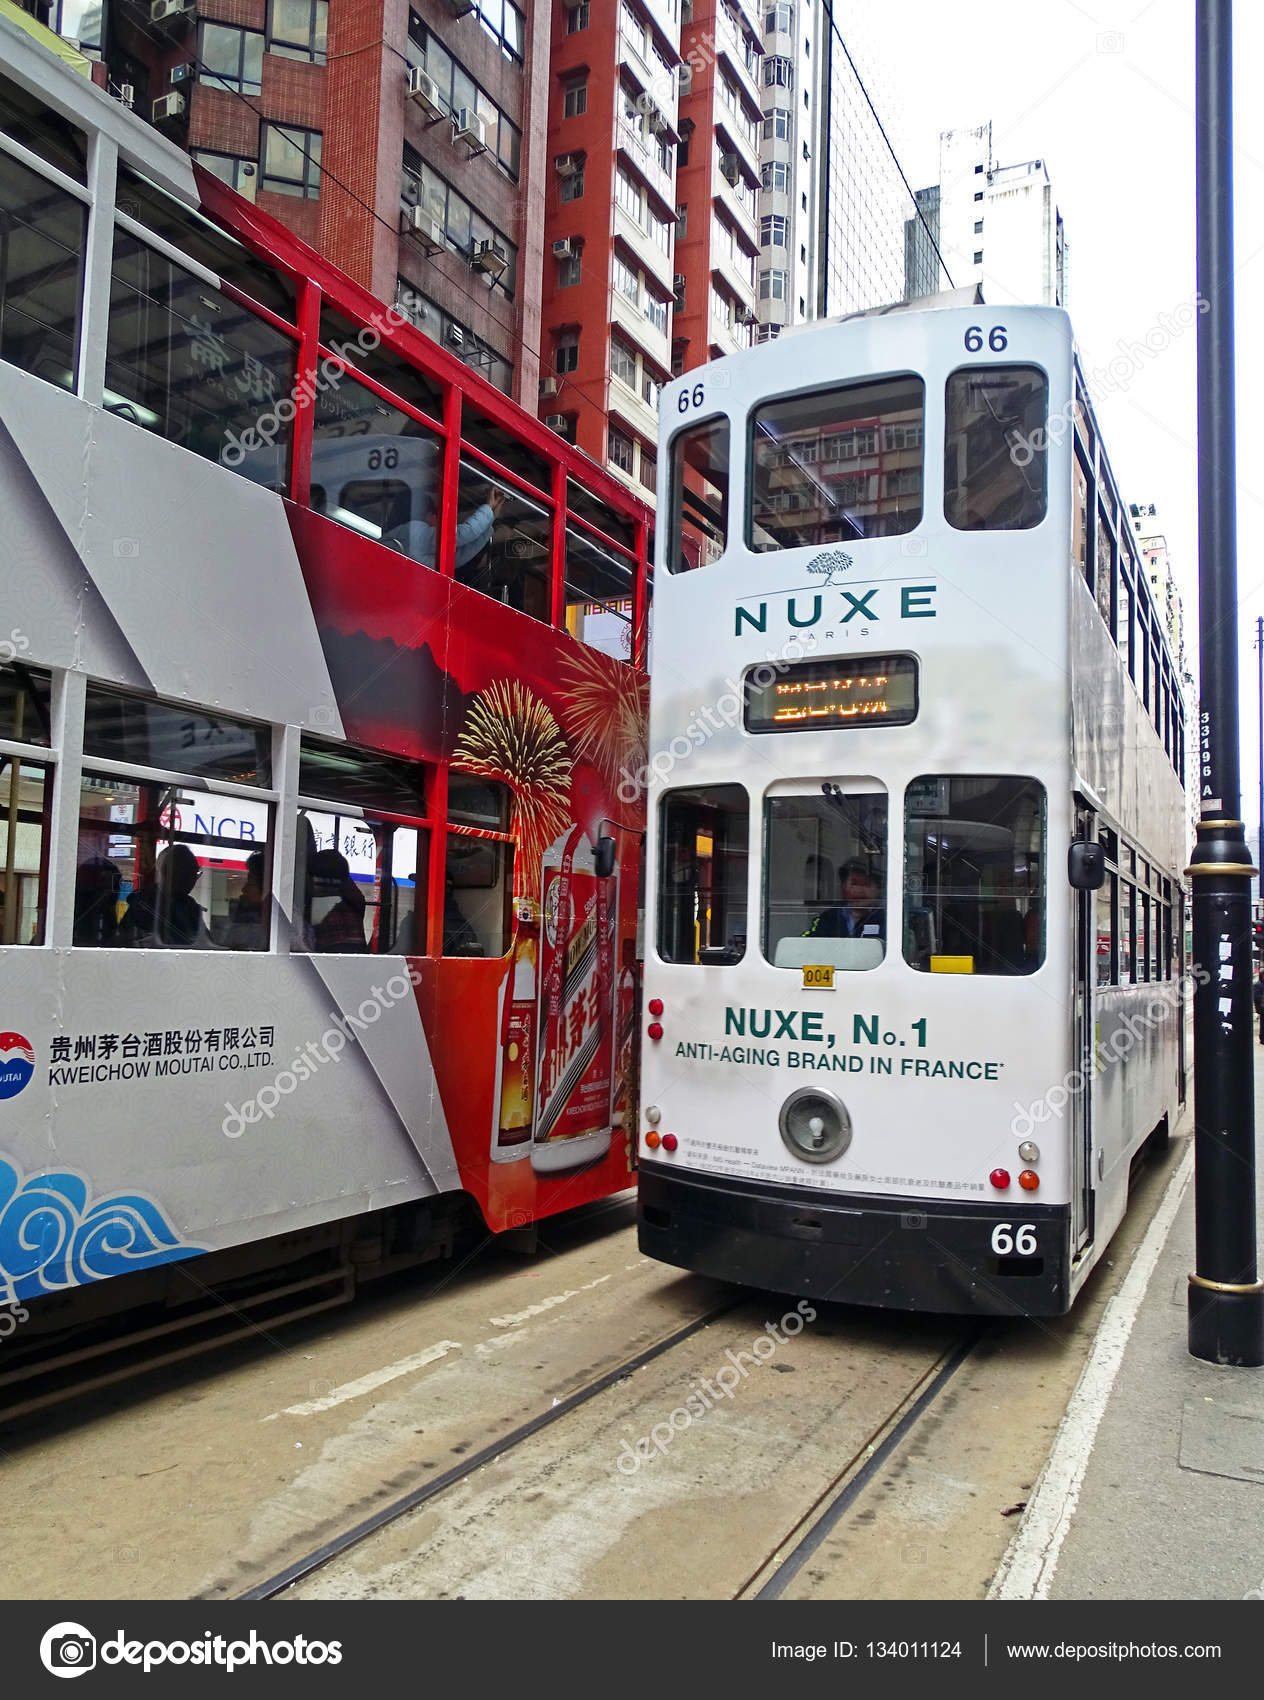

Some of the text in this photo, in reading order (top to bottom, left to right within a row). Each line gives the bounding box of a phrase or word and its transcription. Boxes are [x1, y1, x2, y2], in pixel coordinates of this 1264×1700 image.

[964, 326, 1008, 352] 66
[677, 383, 704, 414] 66
[735, 585, 937, 637] NUXE
[789, 628, 870, 642] PARIS
[1200, 712, 1213, 797] 33196 A
[805, 969, 831, 984] 004
[50, 1025, 275, 1063] 贵州茅台酒股份有限公司
[725, 1007, 928, 1049] NUXE, No.1
[49, 1061, 151, 1086] KWEICHOW
[155, 1055, 214, 1077] MOUTAI
[675, 1041, 780, 1066] ANTI-AGING
[787, 1051, 864, 1073] BRAND
[870, 1056, 893, 1075] IN
[991, 1223, 1038, 1256] 66
